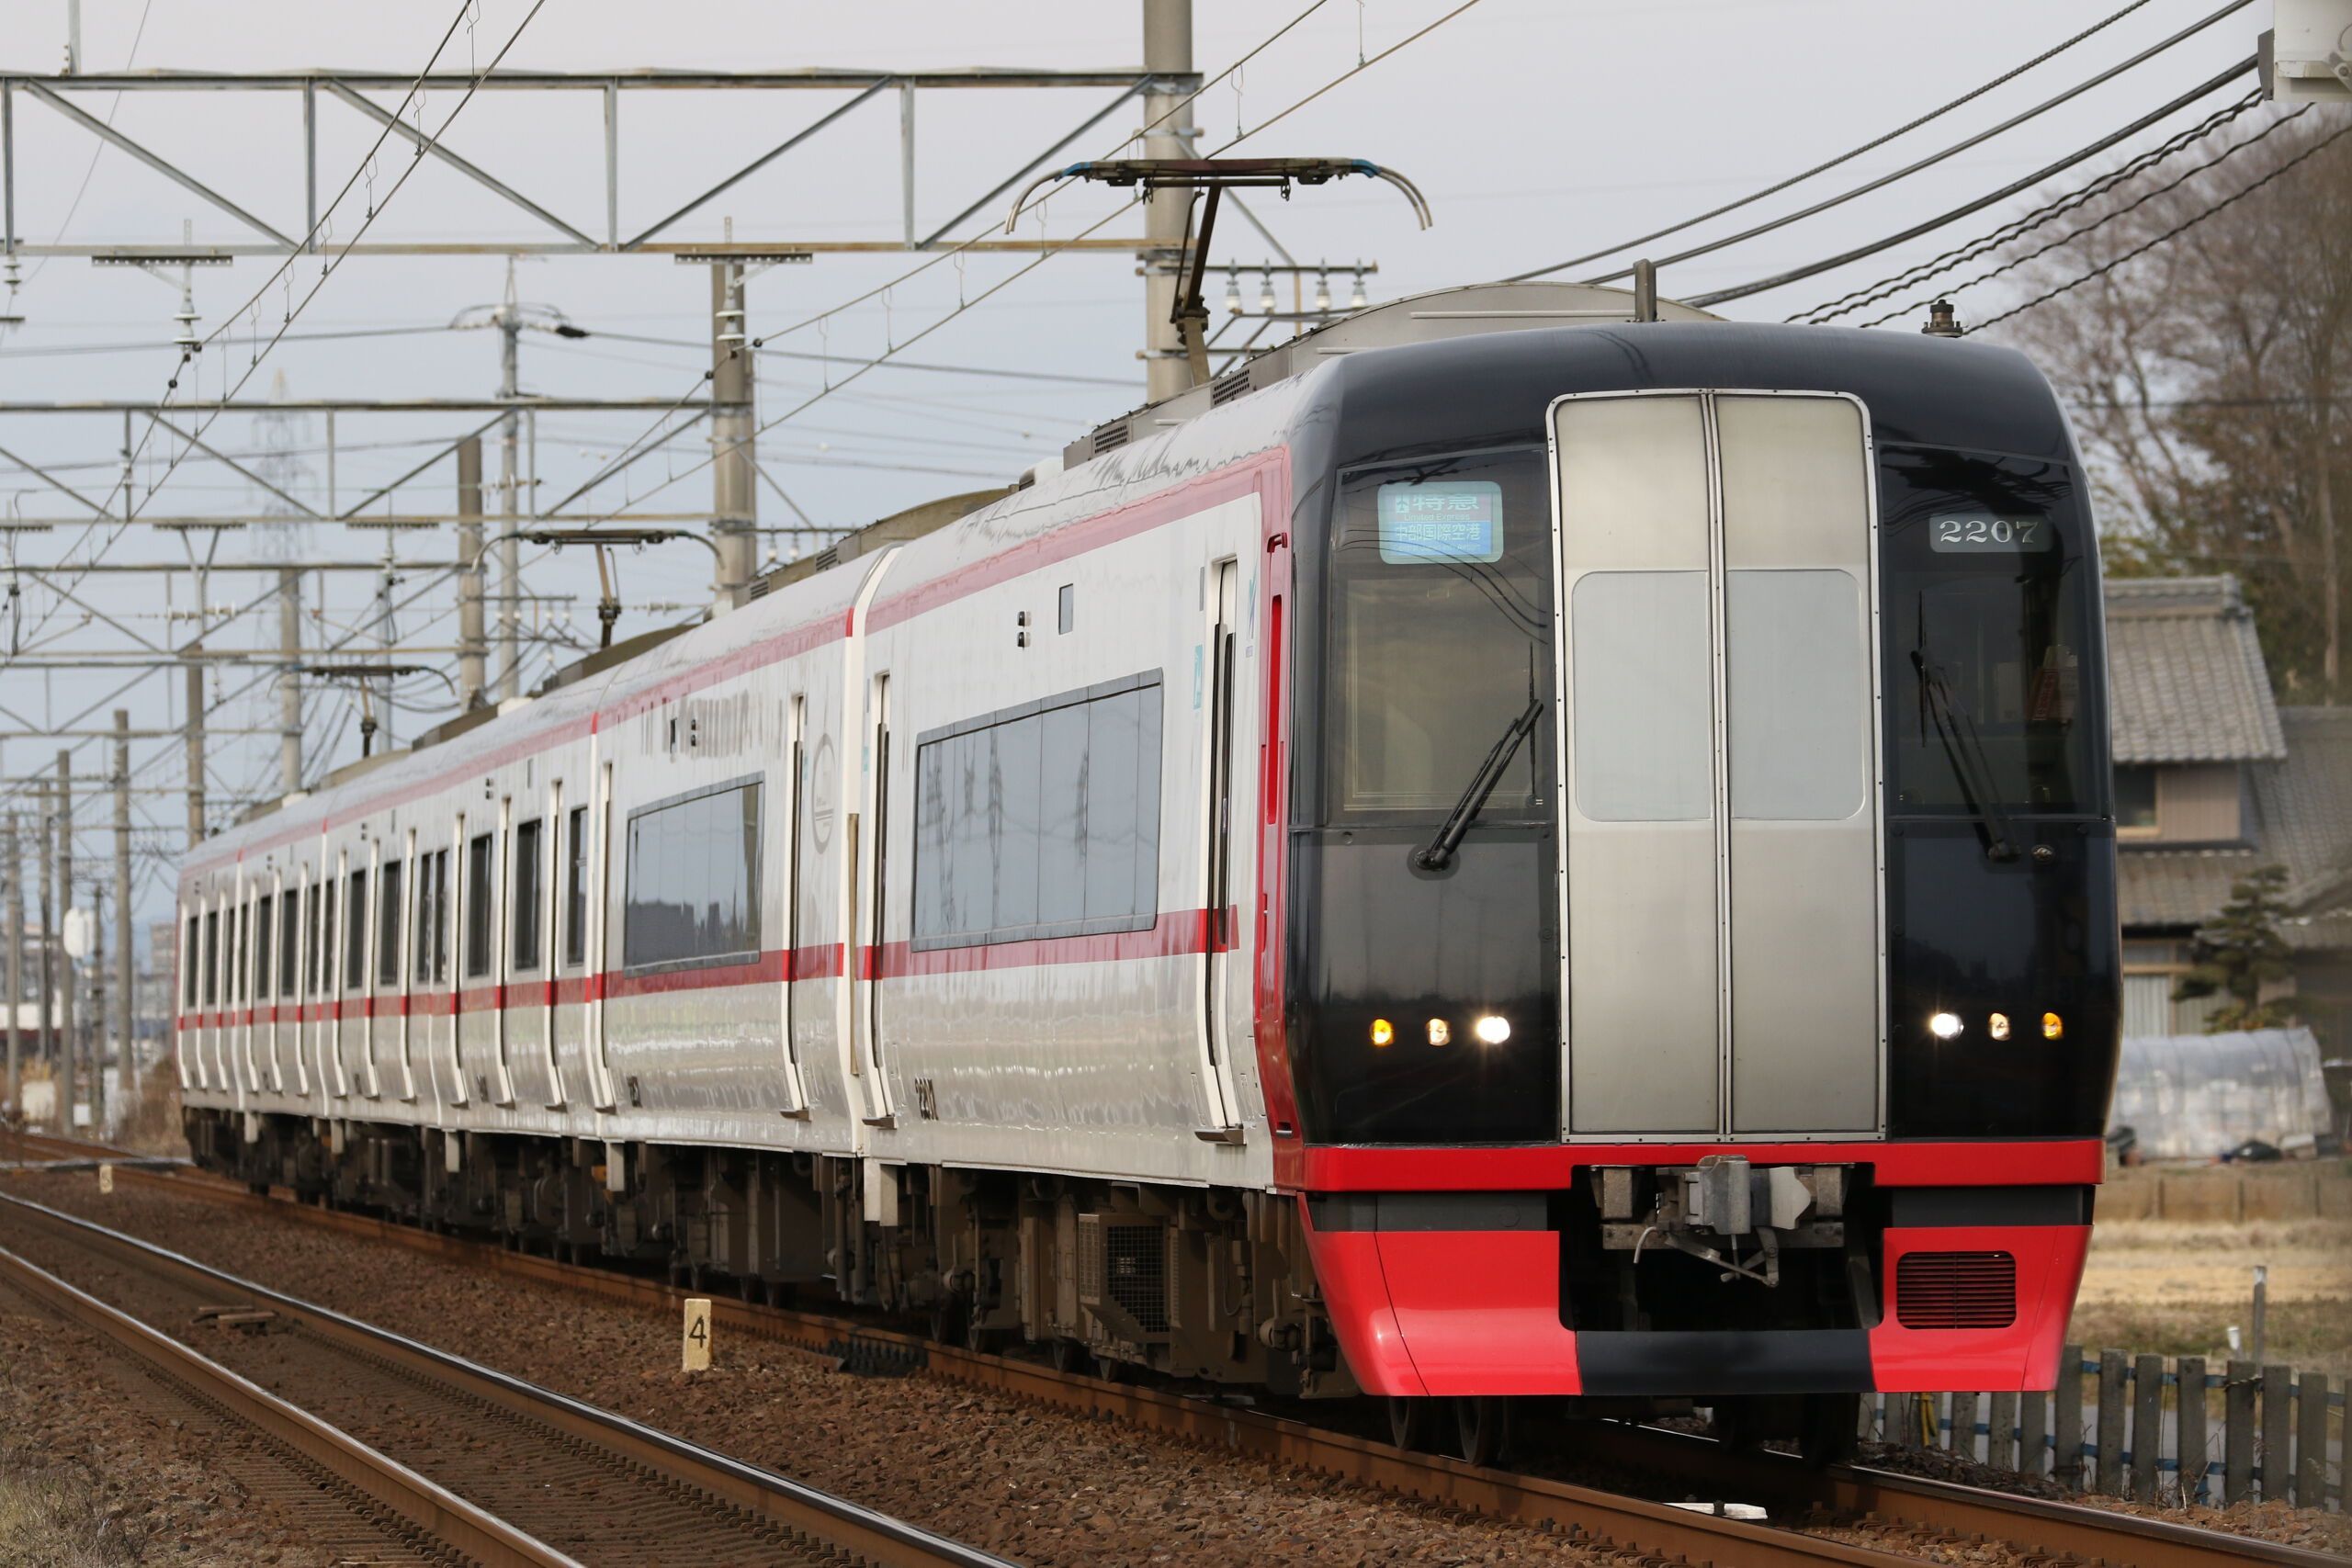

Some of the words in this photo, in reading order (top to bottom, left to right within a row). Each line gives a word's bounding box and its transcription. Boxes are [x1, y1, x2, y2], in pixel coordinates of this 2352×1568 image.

[1412, 494, 1479, 511] 特急
[1396, 523, 1481, 541] 中部国際空港
[1939, 520, 2039, 544] 2207
[688, 1314, 707, 1348] 4
